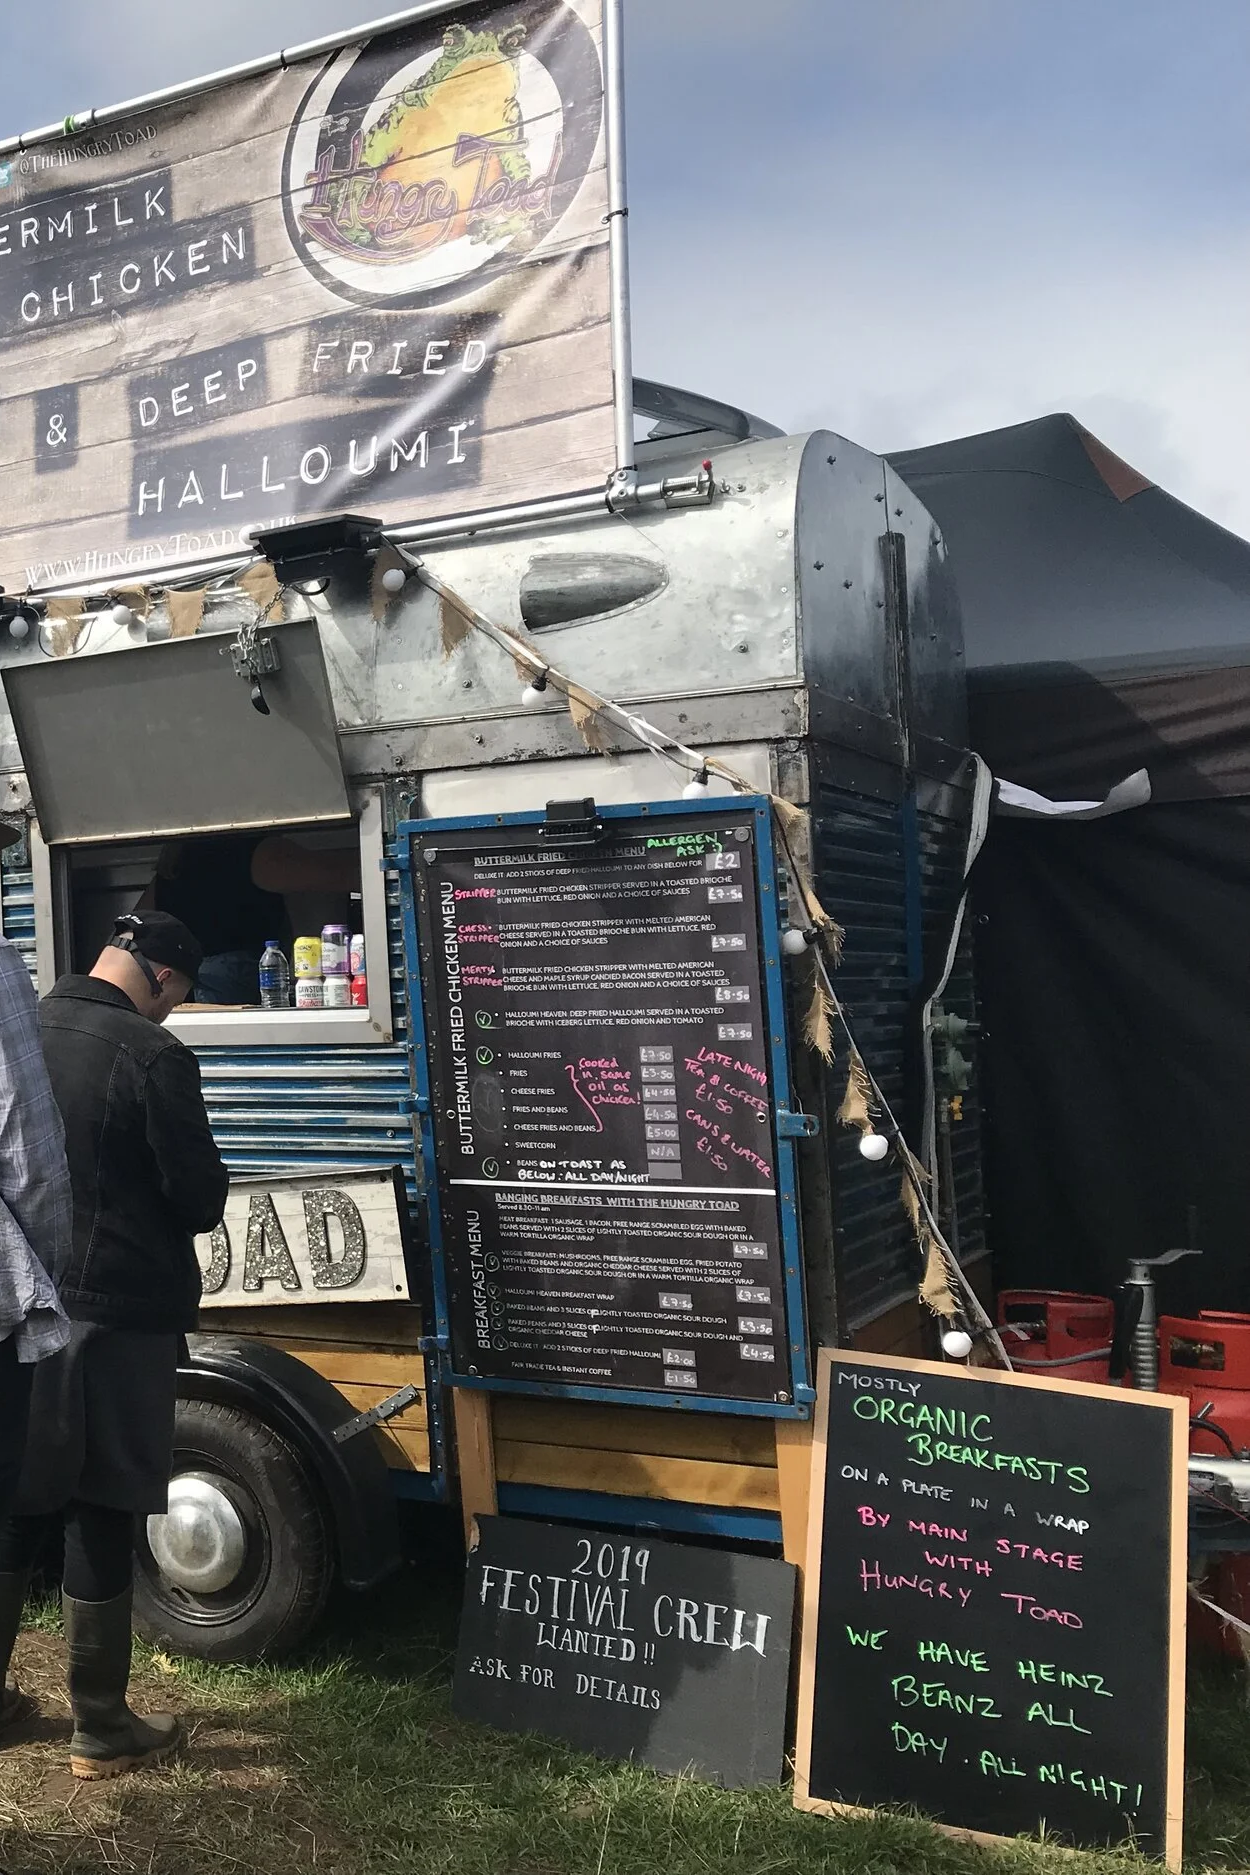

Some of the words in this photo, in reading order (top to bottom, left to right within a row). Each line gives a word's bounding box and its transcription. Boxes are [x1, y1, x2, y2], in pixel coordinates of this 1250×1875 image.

[452, 133, 562, 222] Toad
[21, 227, 246, 322] CHICKEN
[45, 413, 68, 447] &
[139, 358, 256, 427] DEEP
[311, 340, 488, 376] FRIED
[136, 422, 475, 516] HALLOUMI
[647, 832, 718, 848] ALLERGEN
[676, 845, 704, 857] ASK
[715, 853, 737, 869] £2
[440, 882, 455, 929] MENU
[444, 931, 463, 1002] CHICKEN
[502, 967, 542, 975] BUTTERMILK
[544, 966, 562, 974] FRIED
[564, 965, 593, 973] CHICKEN
[595, 964, 627, 972] STRIPPER
[649, 962, 677, 970] MELTED
[678, 961, 714, 969] AMERICAN
[450, 1005, 467, 1051] FRIED
[697, 1047, 732, 1067] LATE
[453, 1056, 475, 1155] BUTTERMILK
[565, 1171, 587, 1181] ALL
[611, 1160, 627, 1169] AS
[495, 1193, 538, 1202] BANGING
[540, 1194, 602, 1205] BREAKFASTS
[607, 1197, 635, 1206] WITH
[637, 1198, 659, 1208] THE
[660, 1199, 706, 1210] HUNGRY
[709, 1201, 739, 1210] TOAD
[467, 1210, 483, 1257] MENU
[471, 1260, 491, 1349] BREAKFAST
[837, 1371, 922, 1398] MOSTLY
[852, 1395, 994, 1444] ORGANIC
[907, 1433, 1092, 1495] BREAKFASTS
[840, 1463, 869, 1483] ON
[876, 1472, 890, 1486] A
[901, 1478, 954, 1503] PLATE
[970, 1496, 990, 1511] IN
[1003, 1501, 1016, 1517] A
[1036, 1511, 1091, 1536] WRAP
[571, 1539, 651, 1586] 2019
[908, 1519, 968, 1543] MAIN
[996, 1537, 1084, 1573] STAGE
[924, 1550, 993, 1578] WITH
[480, 1565, 635, 1632] FESTIVAL
[654, 1594, 772, 1658] CREW
[1000, 1592, 1085, 1630] TOAD
[469, 1656, 511, 1681] ASK
[520, 1664, 556, 1690] FOR
[575, 1673, 662, 1711] DETAILS
[846, 1624, 890, 1651] WE
[918, 1640, 991, 1673] HAVE
[1018, 1660, 1114, 1698] HEINZ
[891, 1675, 1003, 1719] BEANZ
[1027, 1701, 1093, 1735] ALL
[891, 1721, 951, 1765] DAY
[980, 1750, 1027, 1779] ALL
